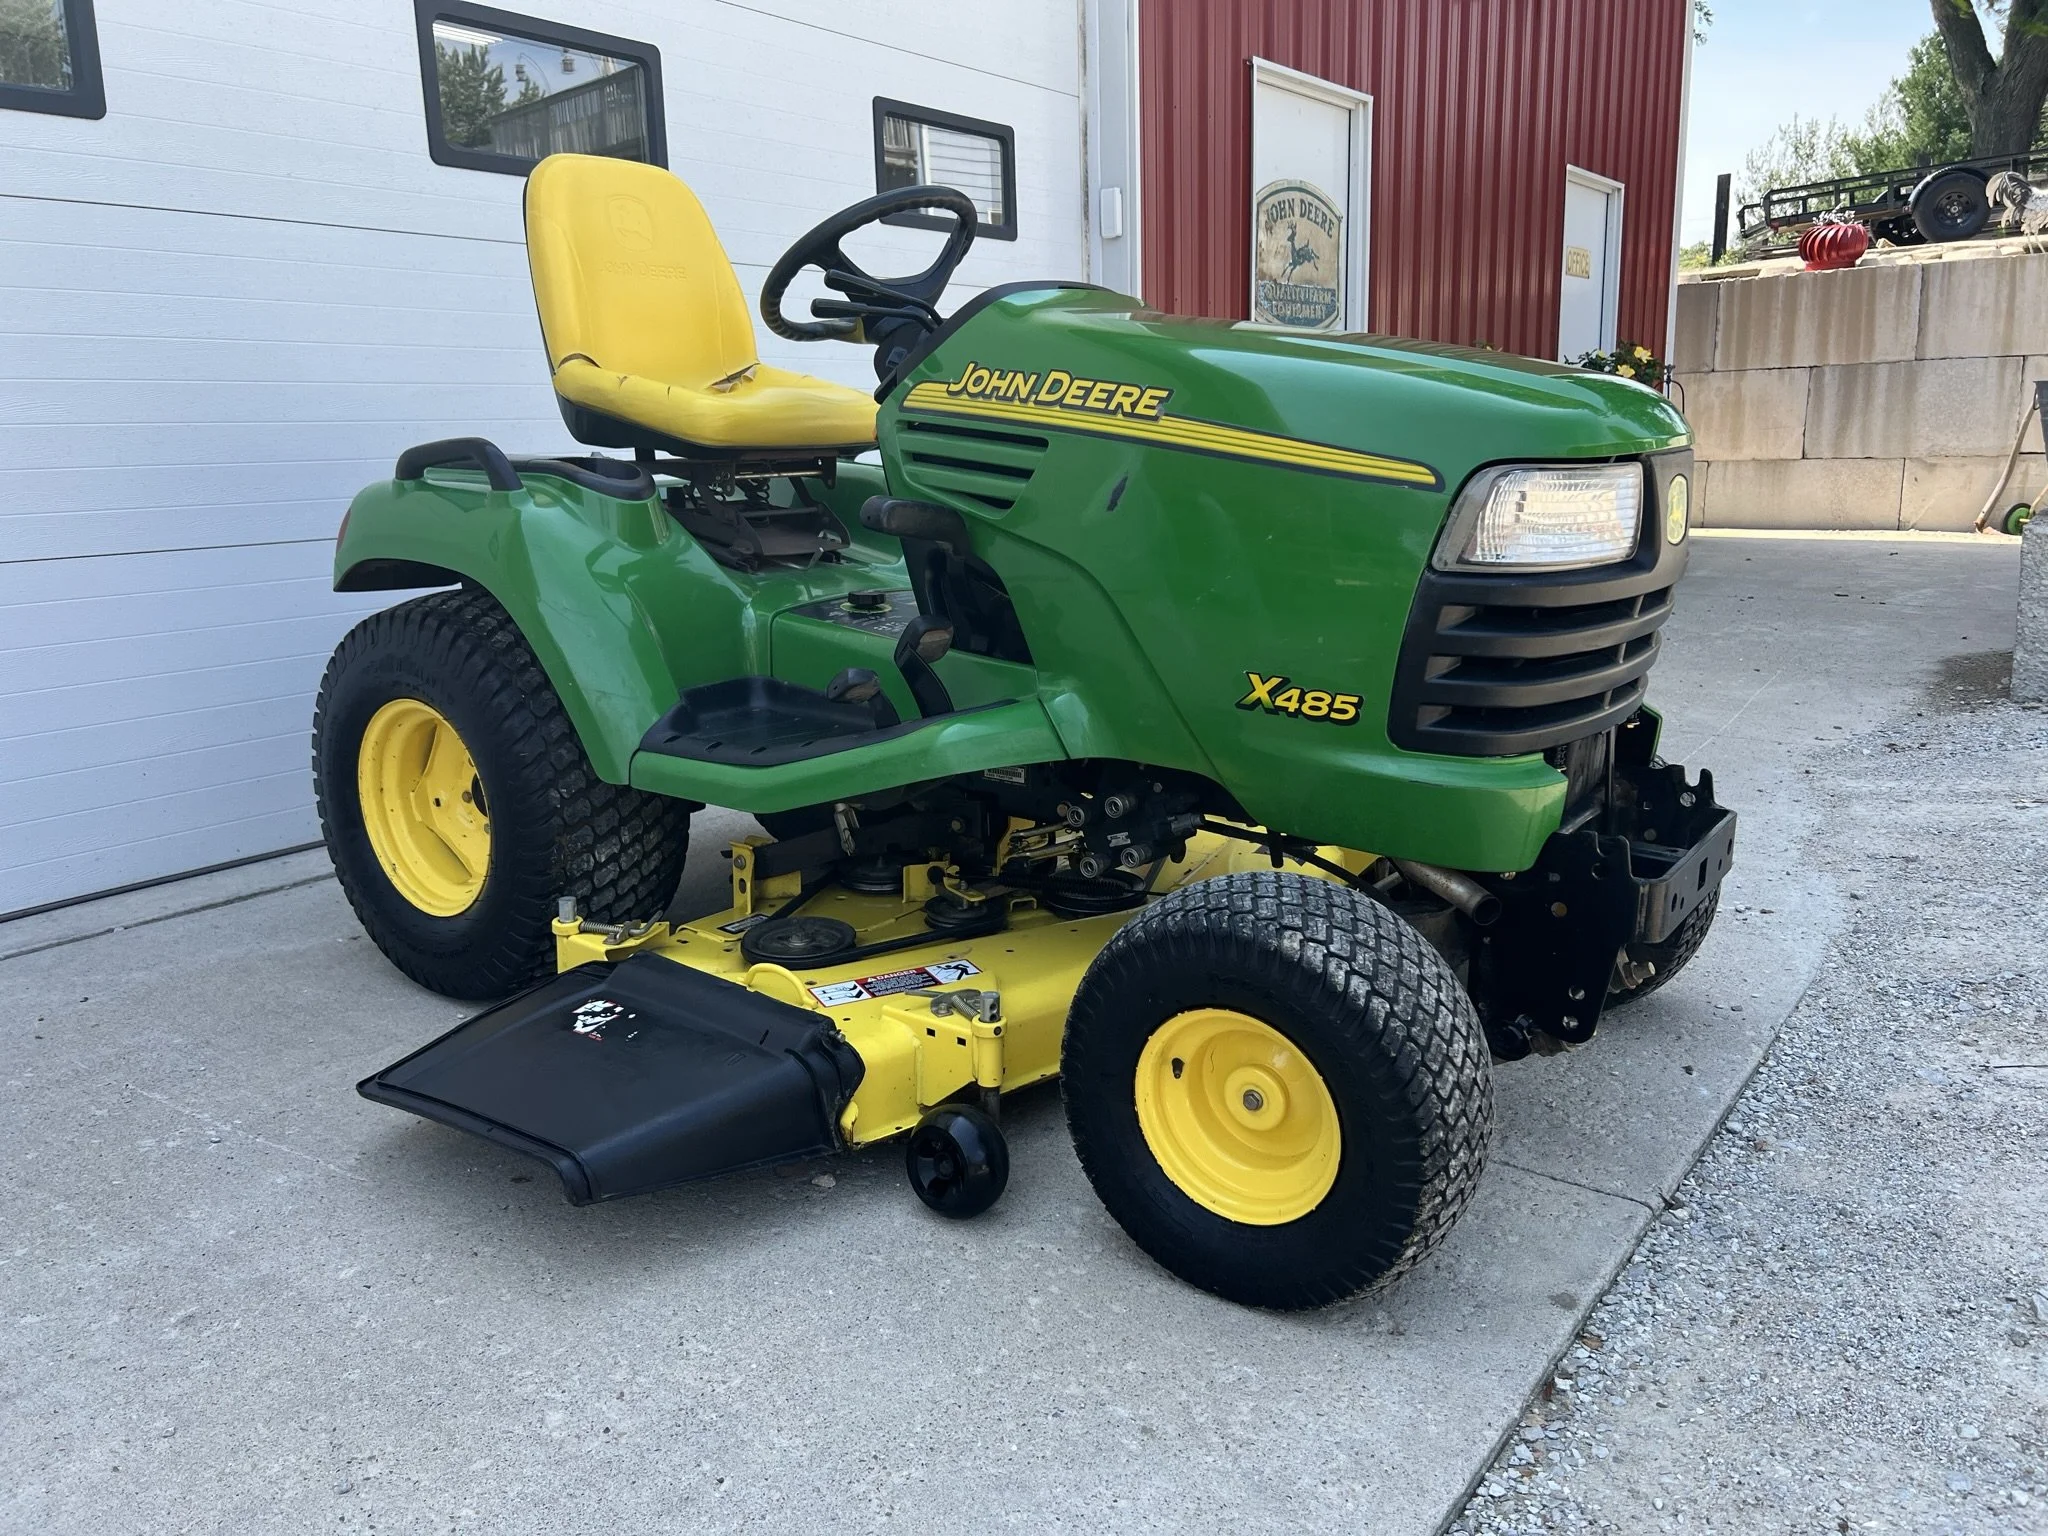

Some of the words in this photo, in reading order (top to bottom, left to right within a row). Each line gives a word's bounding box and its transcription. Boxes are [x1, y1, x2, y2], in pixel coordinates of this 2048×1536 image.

[1265, 198, 1295, 224] JOHN
[1300, 198, 1335, 239] DEERE
[947, 362, 1039, 402] JOHN
[1034, 370, 1172, 419] DEERE
[1237, 672, 1362, 723] X485
[876, 969, 918, 980] DANGER
